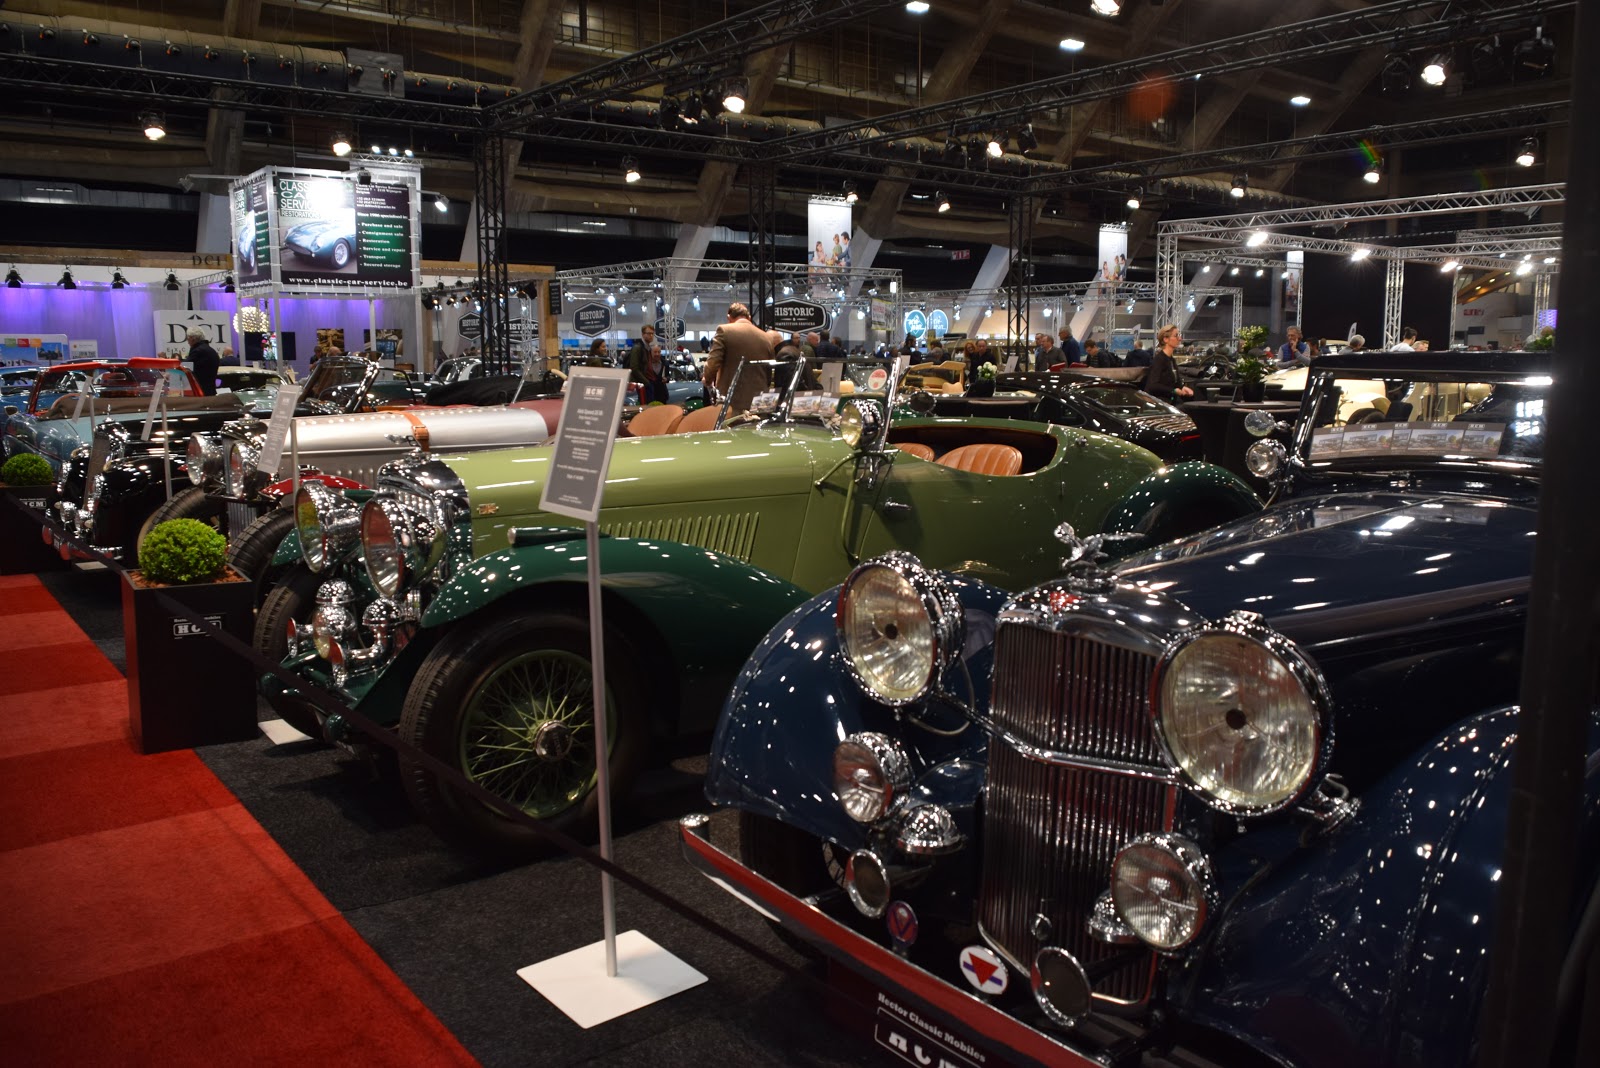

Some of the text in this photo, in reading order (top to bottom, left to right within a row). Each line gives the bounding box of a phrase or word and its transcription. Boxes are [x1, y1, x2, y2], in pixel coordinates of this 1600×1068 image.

[192, 255, 221, 266] DCI
[288, 276, 408, 287] www.classic-car-service.be
[580, 309, 605, 320] HISTORIC
[775, 307, 815, 317] HISTORIC
[166, 323, 226, 343] DCI
[878, 992, 986, 1063] Hector Classic Mobiles
